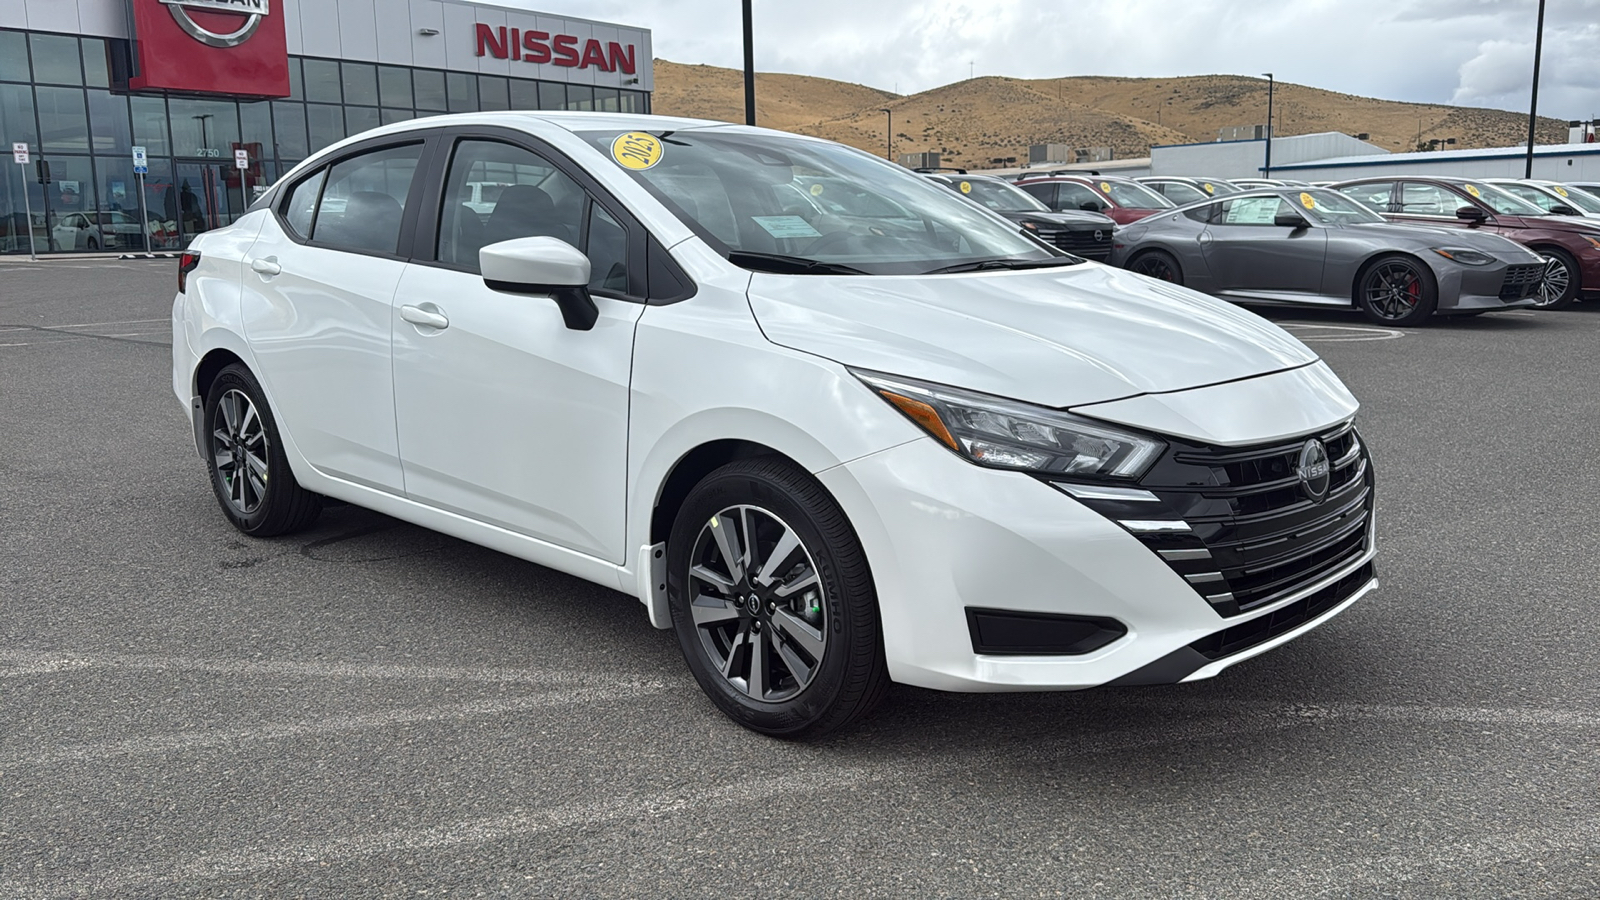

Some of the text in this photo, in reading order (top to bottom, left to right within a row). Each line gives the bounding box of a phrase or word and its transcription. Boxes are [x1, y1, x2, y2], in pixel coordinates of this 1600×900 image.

[475, 22, 636, 75] NISSAN
[196, 148, 220, 158] 2750
[621, 134, 655, 165] 2025
[815, 549, 841, 634] KUMHO
